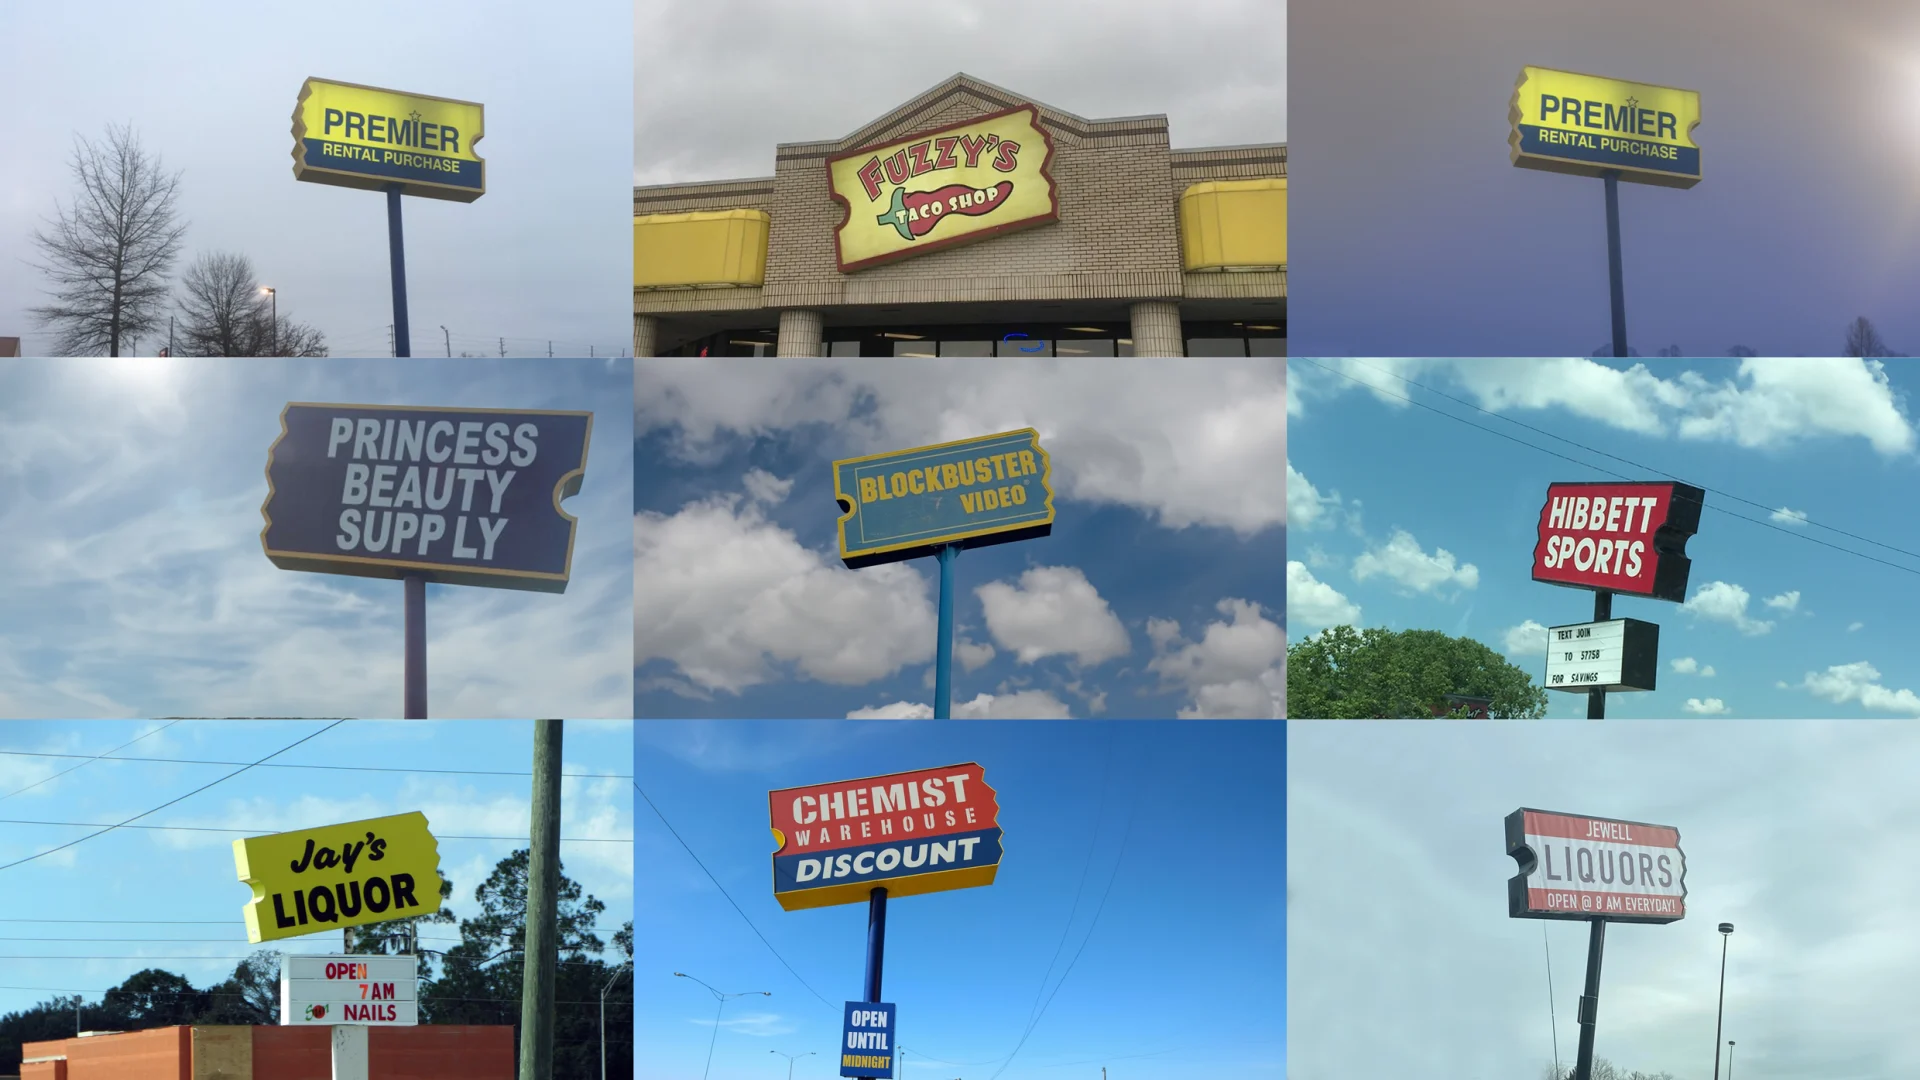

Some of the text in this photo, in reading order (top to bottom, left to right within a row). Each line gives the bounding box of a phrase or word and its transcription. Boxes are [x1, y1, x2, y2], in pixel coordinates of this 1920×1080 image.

[324, 108, 459, 153] PREMIER
[1540, 94, 1677, 140] PREMIER
[323, 143, 460, 173] RENTAL PURCHASE
[1539, 129, 1678, 160] RENTAL PURCHASE
[857, 133, 1021, 202] FUZZY'S
[895, 187, 999, 224] TACO SHOP
[327, 417, 539, 467] PRINCESS
[342, 463, 517, 514] BEAUTY
[860, 450, 1037, 504] BLOCKBUSTER
[960, 484, 1027, 514] VIDEO
[1548, 496, 1657, 533] HIBBETT
[1544, 535, 1645, 578] SPORTS
[1557, 627, 1591, 640] TEXT JOIN
[1564, 649, 1600, 661] TO 57758
[1551, 672, 1598, 684] FOR SAVINGS
[792, 774, 970, 825] CHEMIST
[795, 807, 977, 847] WAREHOUSE
[1586, 820, 1633, 841] JEWELL
[290, 831, 387, 874] Jay's
[796, 837, 981, 883] DISCOUNT
[1545, 844, 1673, 888] LIQUORS
[272, 873, 419, 929] LIQUOR
[1547, 893, 1676, 913] OPEN @ 8 AM EVERYDAY!
[325, 962, 367, 980] OPEN
[359, 982, 395, 1000] 7 AM
[344, 1004, 397, 1021] NAILS
[851, 1010, 888, 1028] OPEN
[847, 1031, 888, 1050] UNTIL
[842, 1054, 891, 1069] MIDNIGHT
